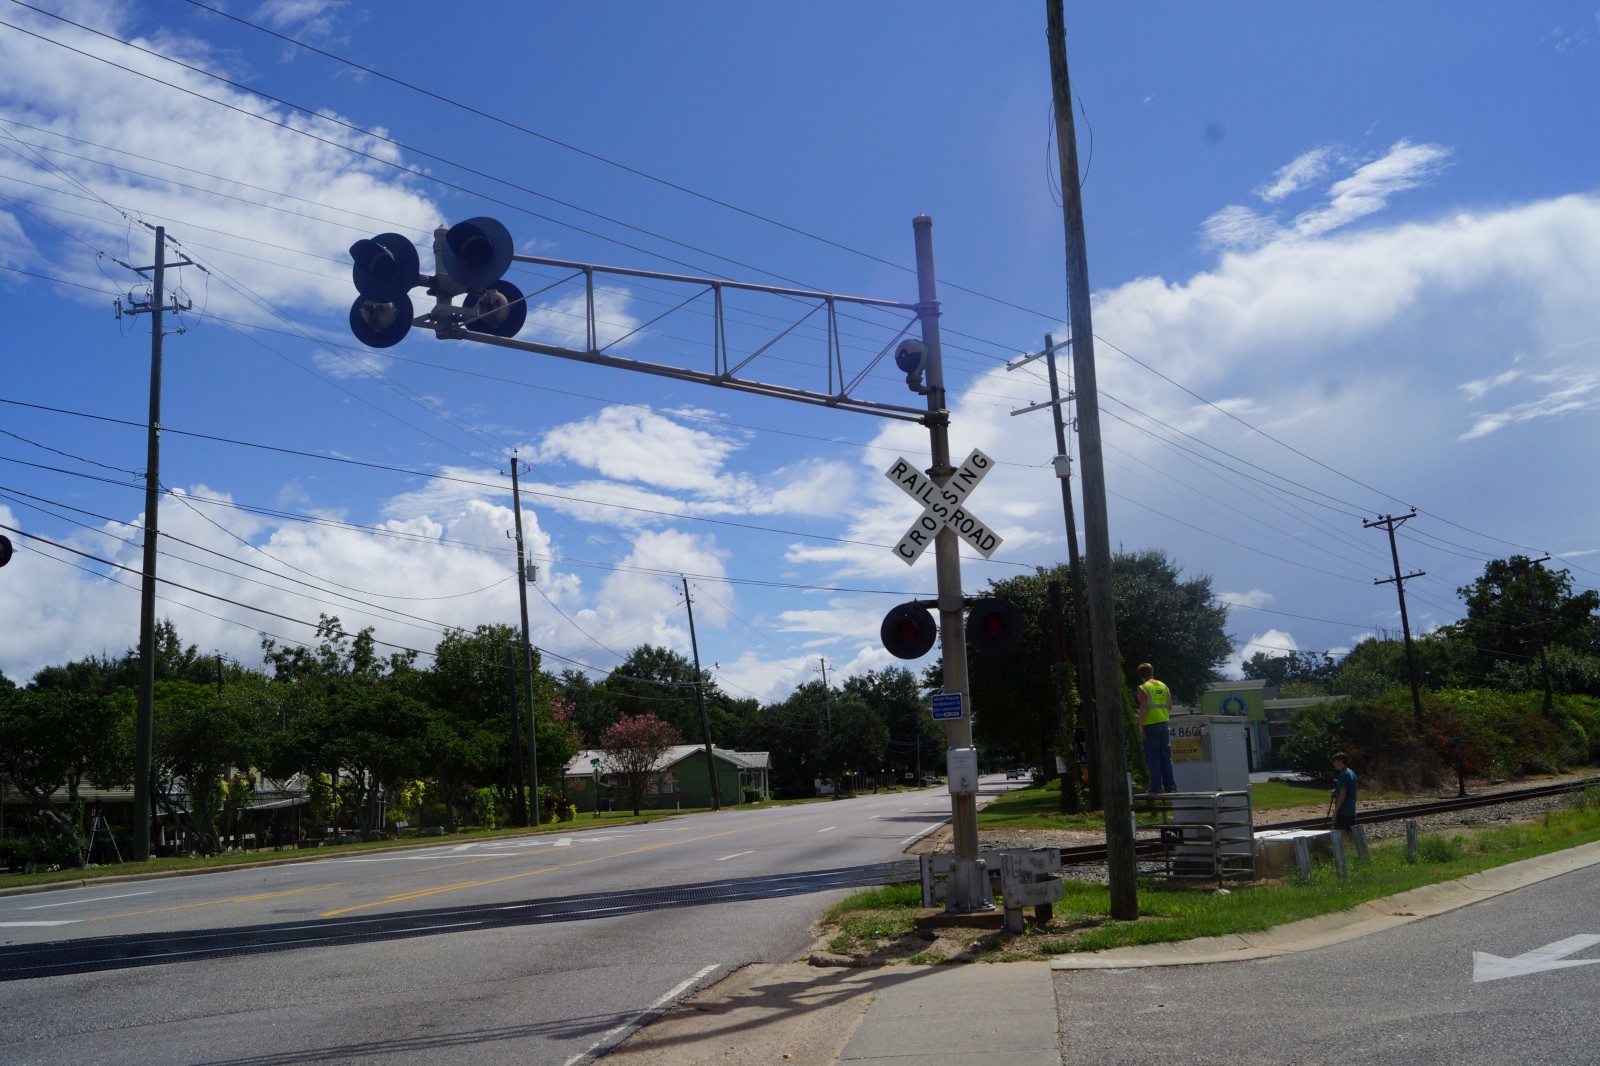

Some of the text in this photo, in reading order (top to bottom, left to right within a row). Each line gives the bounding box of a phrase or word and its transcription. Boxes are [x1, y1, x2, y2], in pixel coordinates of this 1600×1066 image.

[891, 461, 996, 551] RAIL ROAD
[898, 454, 988, 558] CROSSING
